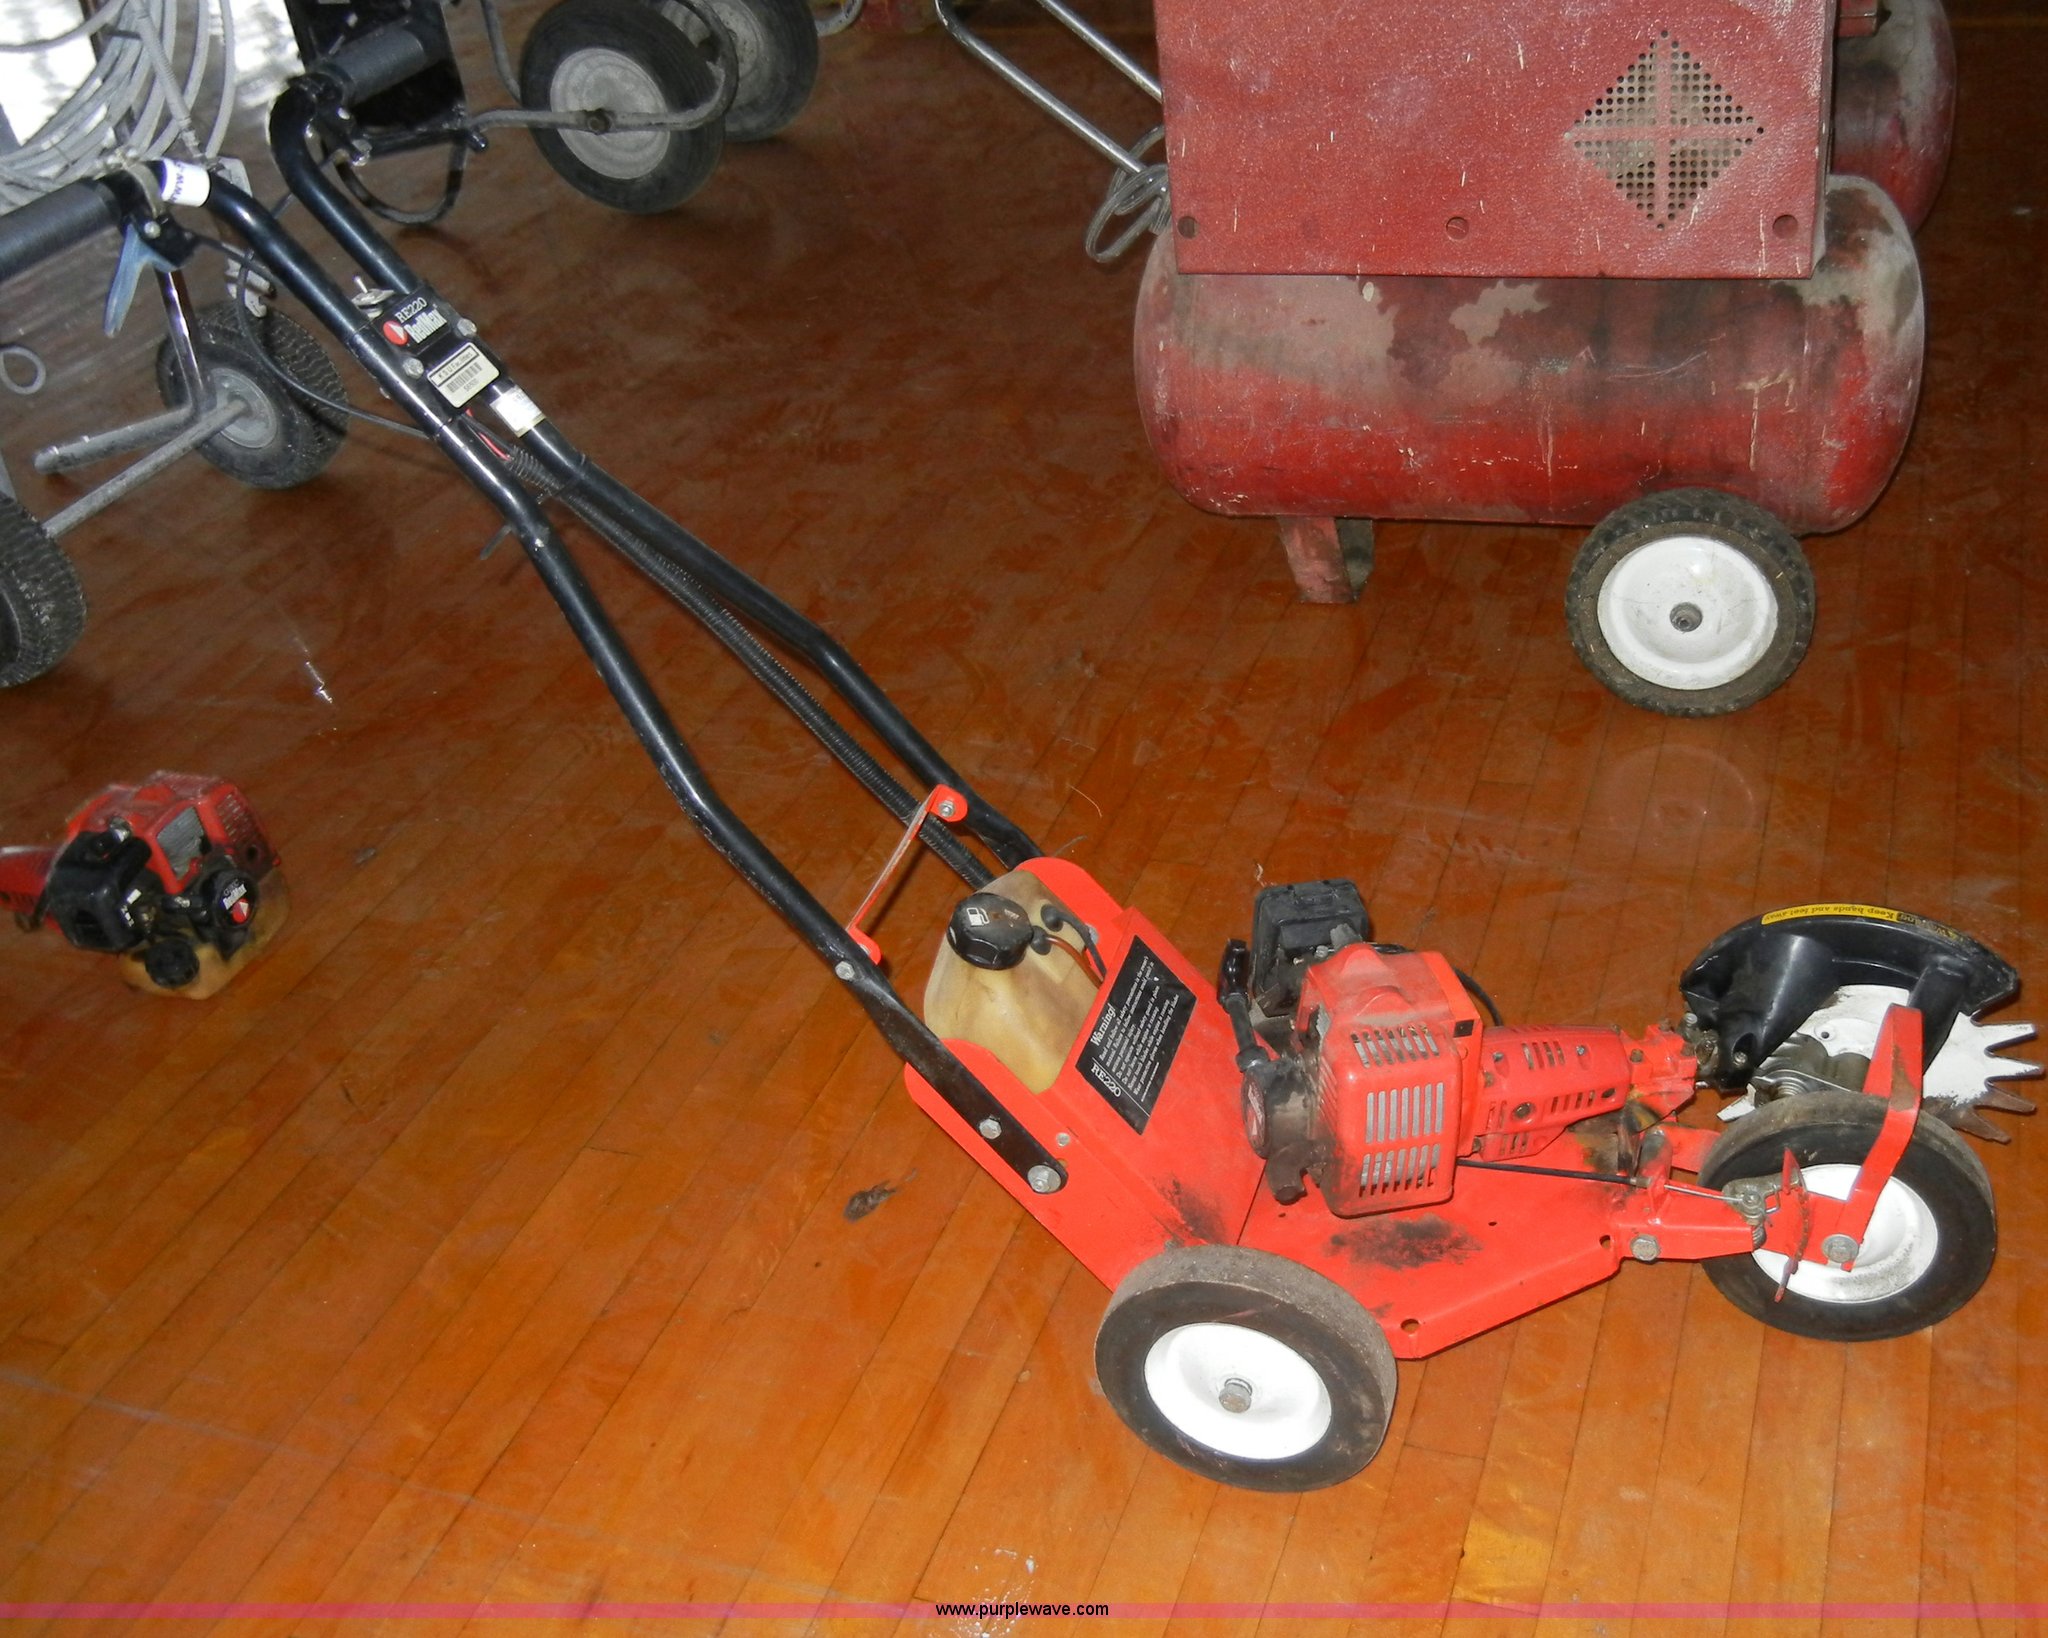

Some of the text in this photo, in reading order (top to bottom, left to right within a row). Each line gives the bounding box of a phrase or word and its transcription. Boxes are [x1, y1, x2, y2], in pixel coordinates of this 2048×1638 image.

[394, 297, 428, 324] RE220
[403, 308, 447, 344] RedMax
[1834, 906, 1864, 914] hands
[1867, 908, 1894, 919] Keep
[1090, 1002, 1115, 1046] Warning!
[1091, 1062, 1121, 1098] RE220
